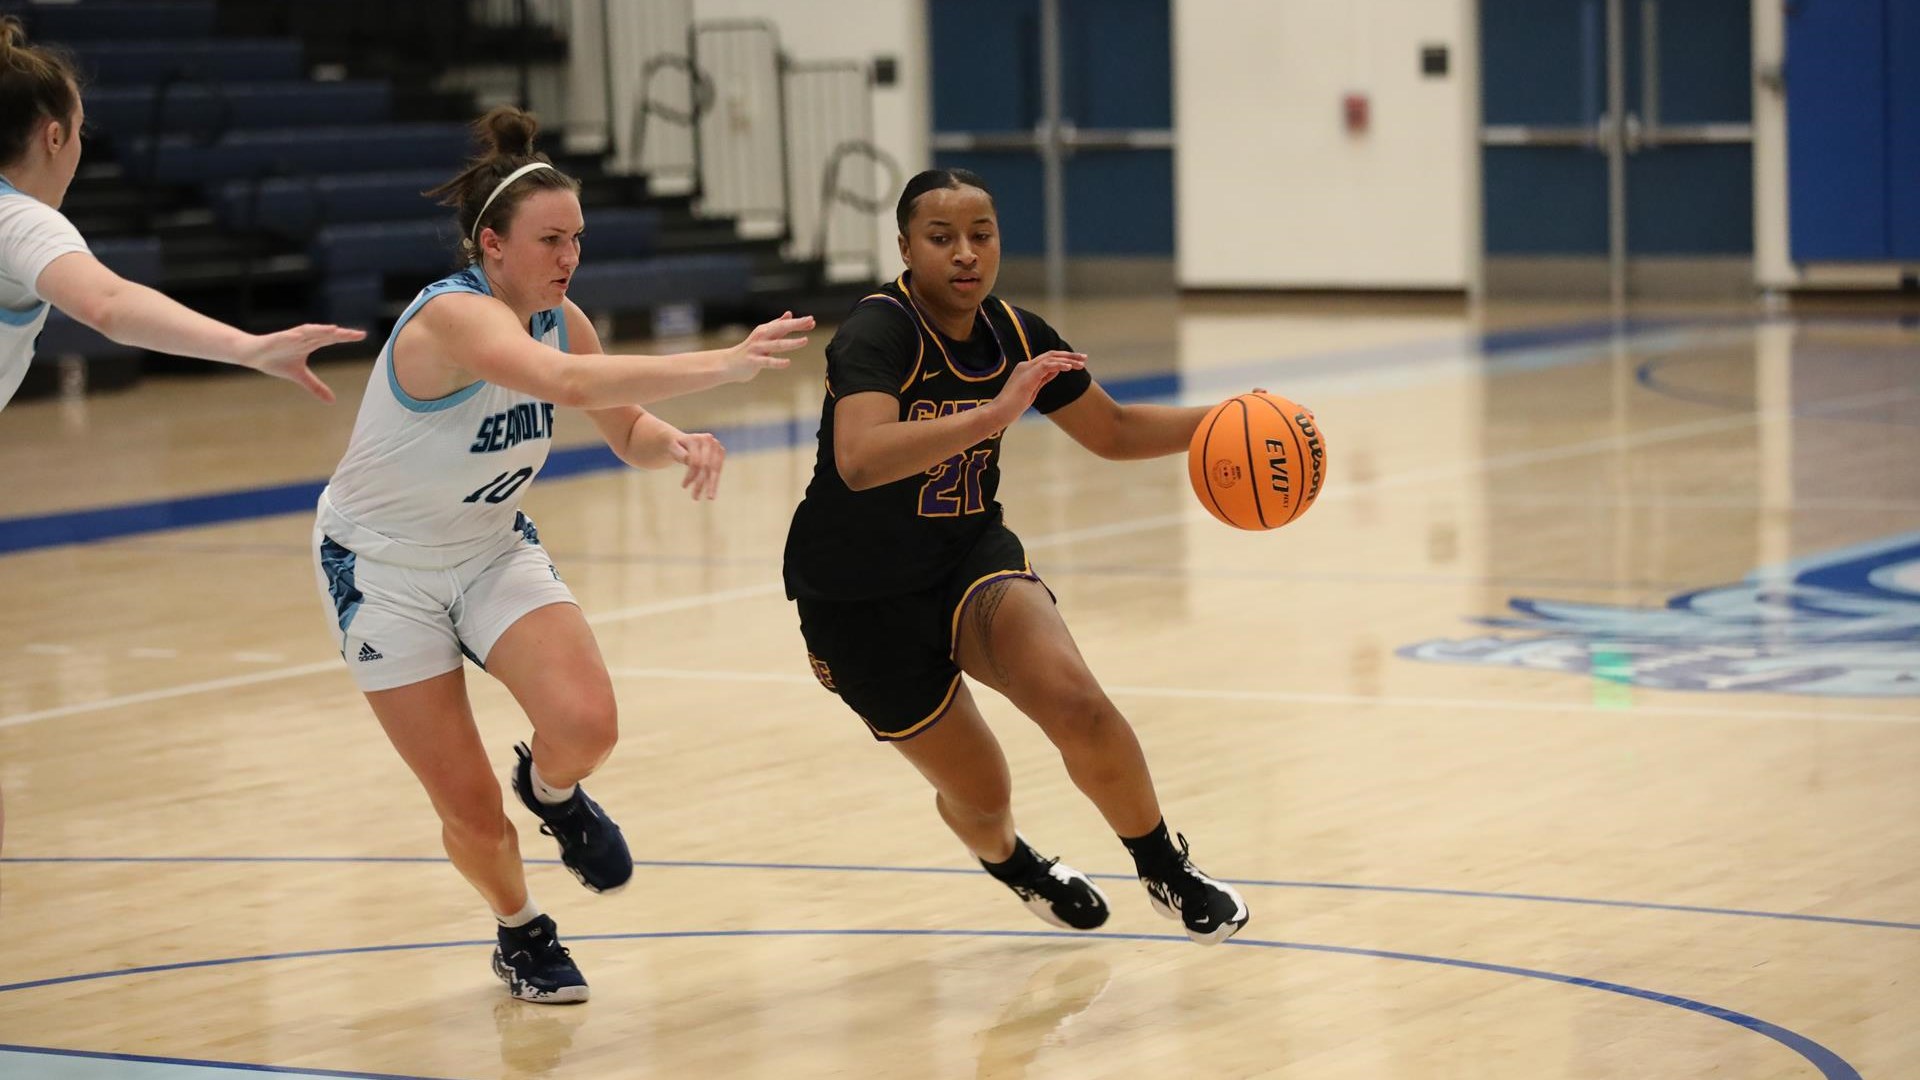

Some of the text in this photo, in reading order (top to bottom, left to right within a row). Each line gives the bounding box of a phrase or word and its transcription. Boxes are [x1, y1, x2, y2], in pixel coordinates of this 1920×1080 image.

[463, 466, 533, 503] 10
[918, 449, 993, 517] 21
[1265, 439, 1289, 493] EVO
